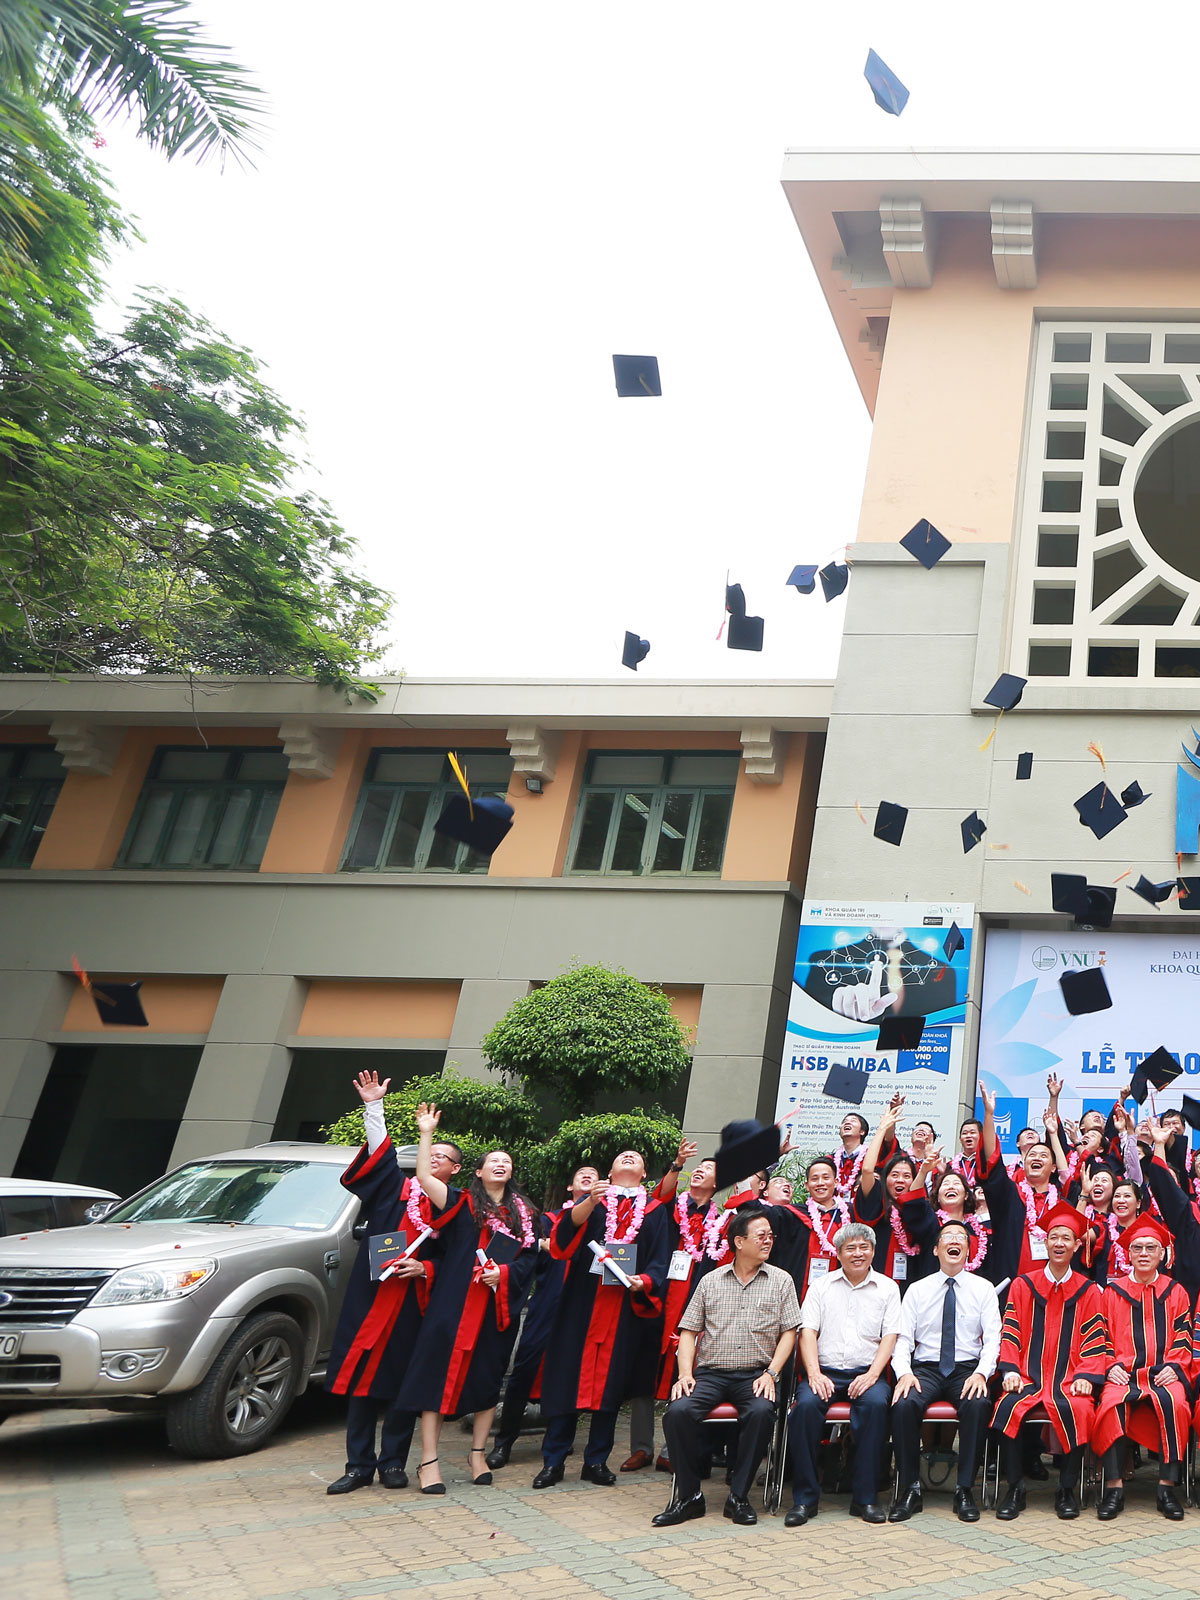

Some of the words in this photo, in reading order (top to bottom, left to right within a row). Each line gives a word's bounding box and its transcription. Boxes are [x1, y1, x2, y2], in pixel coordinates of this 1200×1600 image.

[1061, 953, 1096, 967] VNU
[1173, 951, 1192, 961] ĐẠI
[1150, 964, 1183, 973] KHOA
[791, 1056, 828, 1070] HSB
[847, 1057, 891, 1072] MBA
[1082, 1042, 1115, 1073] LỄ
